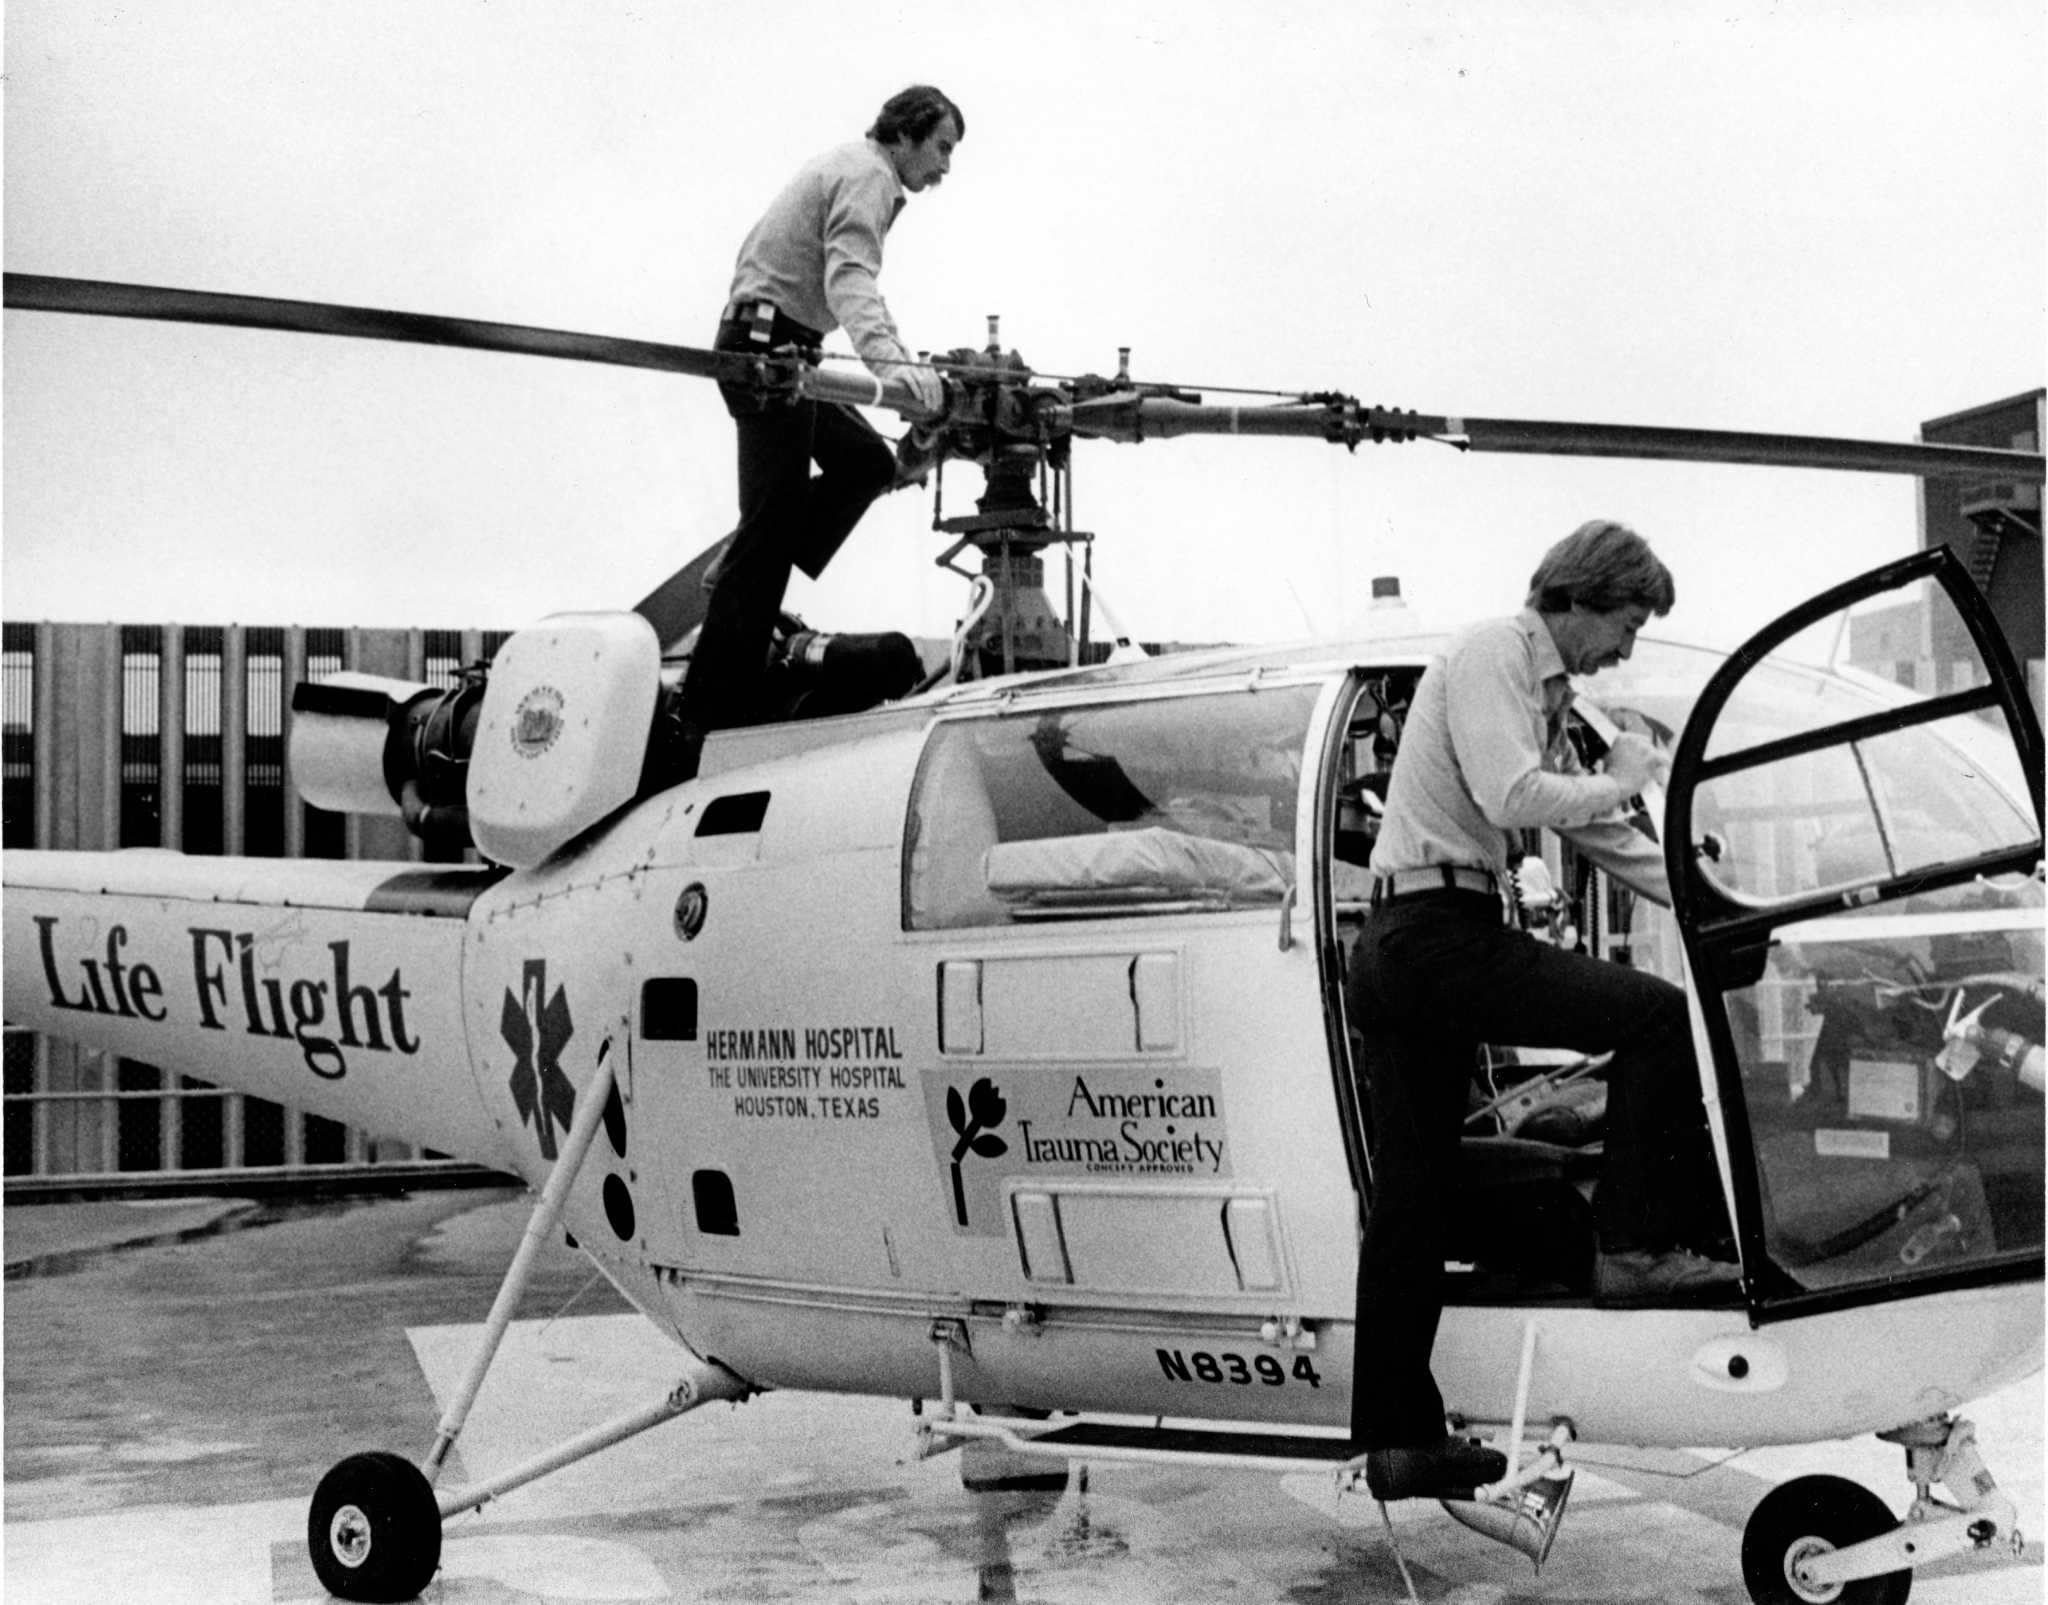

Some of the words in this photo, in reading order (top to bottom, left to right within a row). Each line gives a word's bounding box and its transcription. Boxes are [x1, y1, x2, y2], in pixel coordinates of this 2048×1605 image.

[33, 916, 167, 1022] Life
[188, 927, 420, 1079] Flight
[706, 1029, 796, 1060] HERMANN
[804, 1026, 903, 1059] HOSPITAL
[708, 1066, 731, 1089] THE
[736, 1066, 821, 1089] UNIVERSITY
[829, 1066, 906, 1089] HOSPITAL
[1067, 1075, 1217, 1118] American
[818, 1097, 880, 1118] TEXAS
[1017, 1119, 1121, 1163] Trauma
[1120, 1120, 1224, 1173] Society
[1155, 1349, 1322, 1389] N8394
